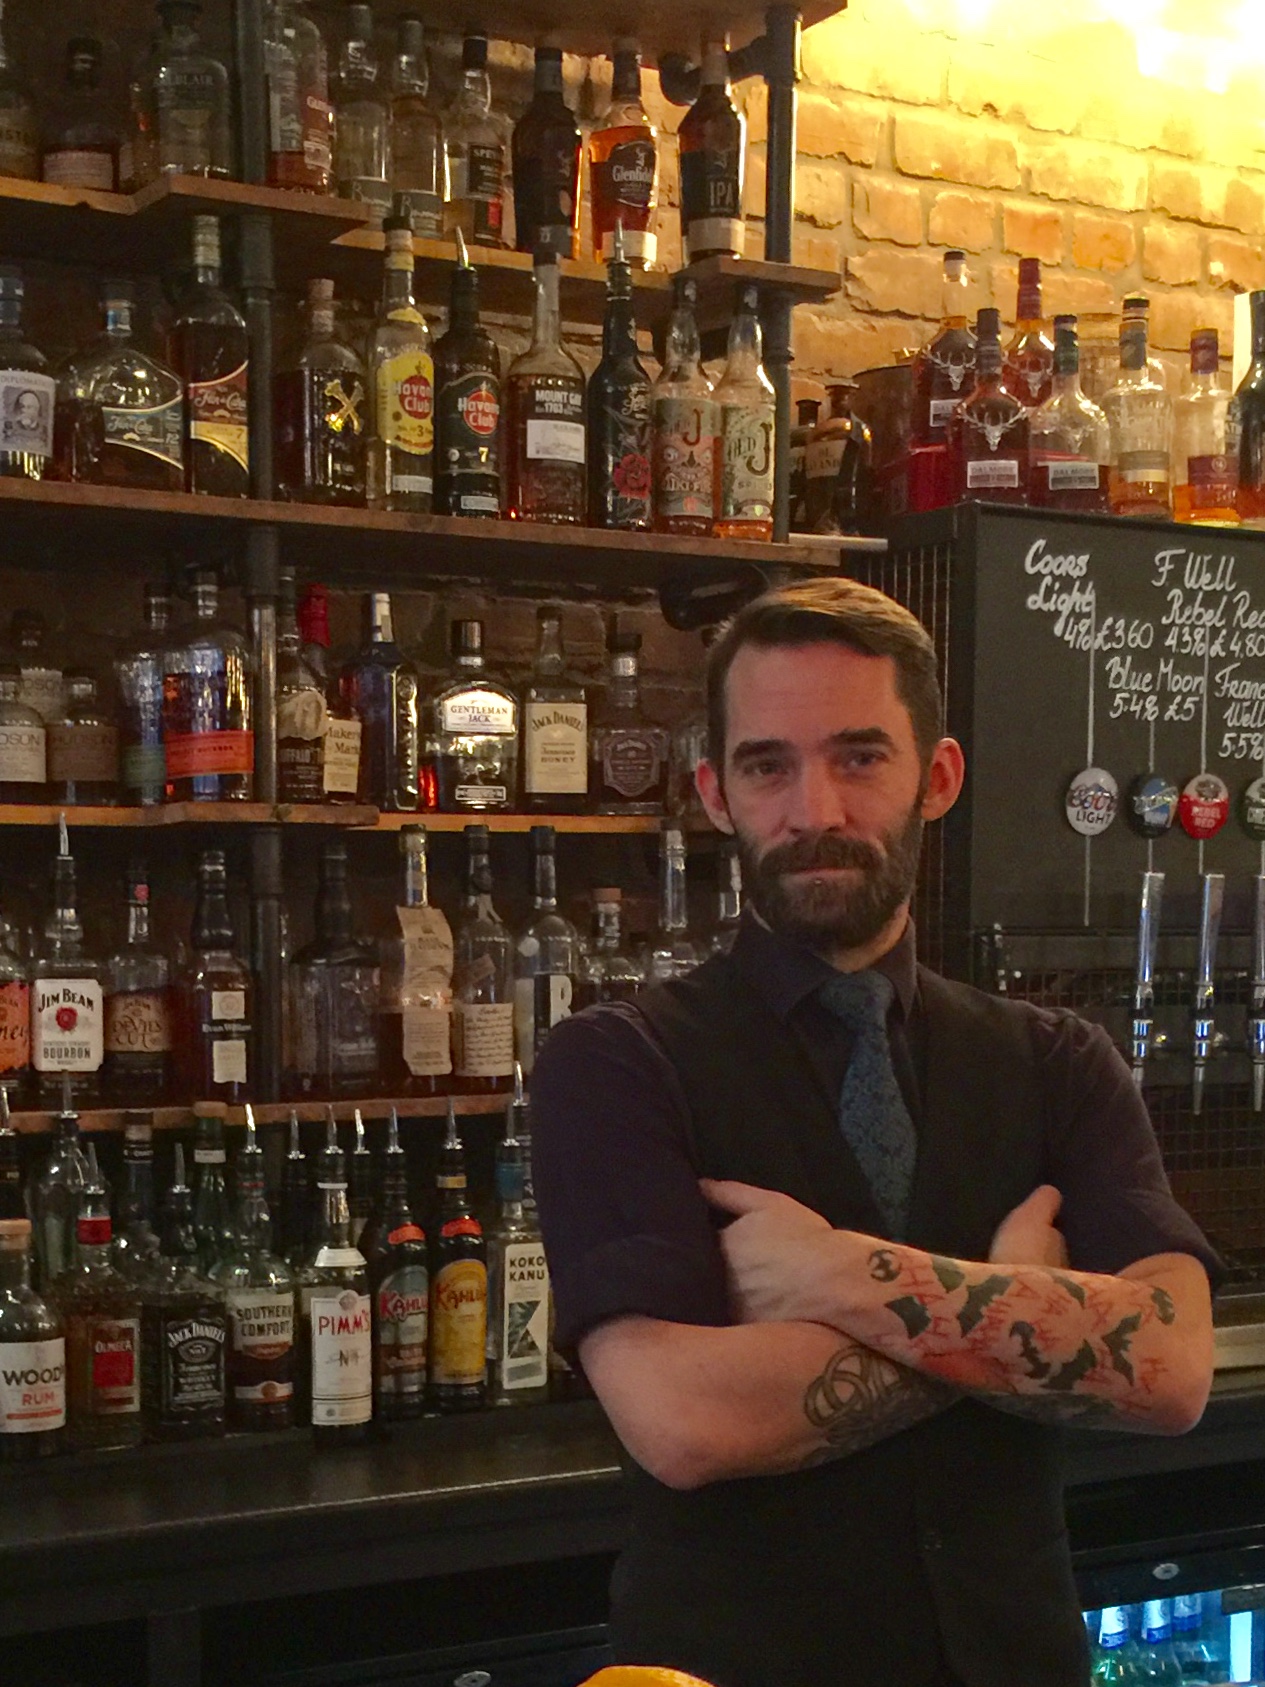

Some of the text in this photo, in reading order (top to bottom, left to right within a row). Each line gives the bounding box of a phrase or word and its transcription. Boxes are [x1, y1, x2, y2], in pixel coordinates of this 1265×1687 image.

[709, 181, 734, 207] IPA
[404, 396, 431, 413] Club
[535, 389, 569, 404] MOUNT
[469, 411, 496, 428] Club
[236, 428, 245, 439] 7
[416, 425, 425, 437] 3
[478, 446, 489, 463] 7
[1024, 539, 1091, 578] Coors
[1183, 551, 1238, 592] Well
[1026, 575, 1096, 637] Light
[1161, 588, 1229, 628] Rebel
[1104, 655, 1204, 694] Blue Moon
[450, 704, 508, 715] GENTLEMAN
[1109, 692, 1200, 722] 5.4% £5
[468, 713, 491, 723] JACK
[532, 715, 552, 732] JACK
[1217, 732, 1264, 762] 5.5%
[1075, 809, 1112, 826] LIGHT
[38, 993, 61, 1013] JIM
[61, 988, 94, 1012] BEAM
[43, 1046, 92, 1060] BOURBON
[509, 1256, 546, 1269] KOKO
[509, 1269, 546, 1282] KANU
[236, 1304, 292, 1322] SOUTHERN
[241, 1320, 290, 1337] COMFORT
[168, 1328, 193, 1348] JACK
[22, 1391, 55, 1406] RUM
